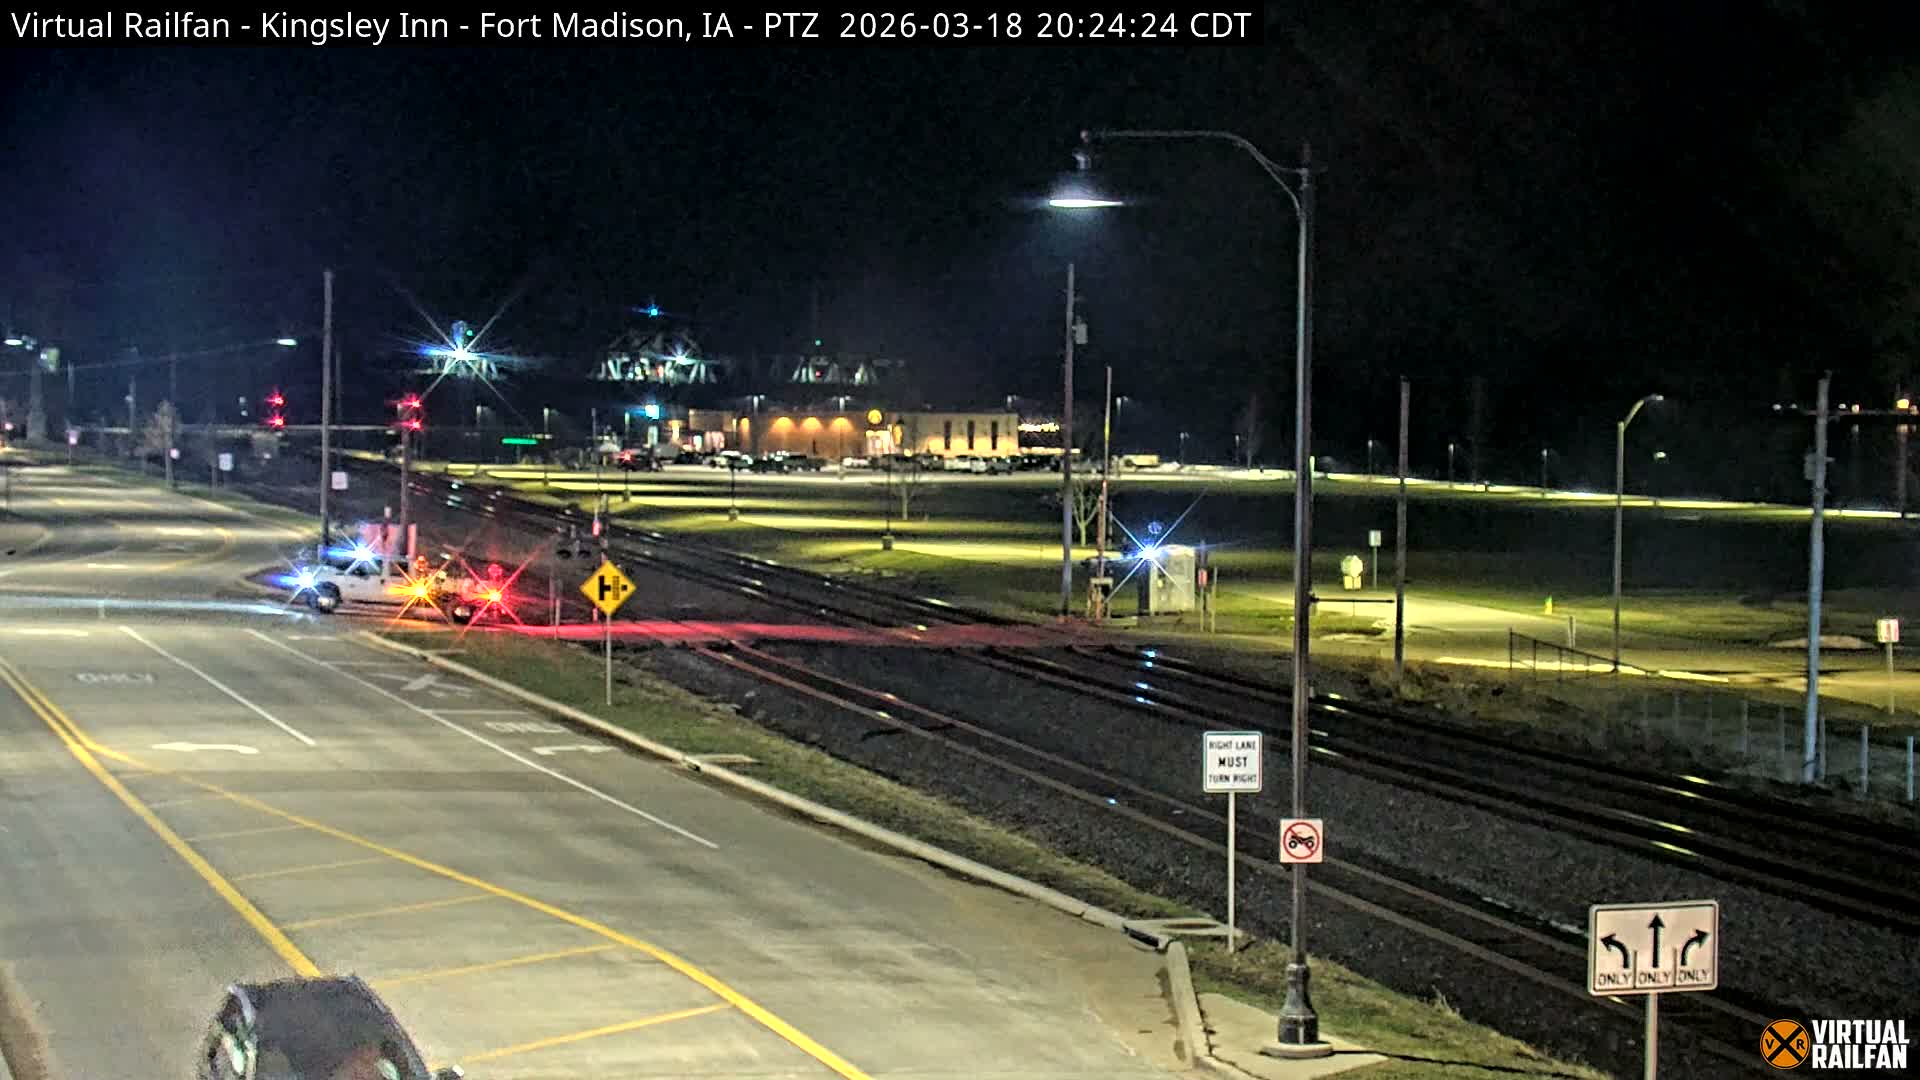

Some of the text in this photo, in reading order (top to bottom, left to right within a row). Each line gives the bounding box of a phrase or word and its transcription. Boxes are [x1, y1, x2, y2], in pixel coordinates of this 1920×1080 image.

[1209, 740, 1256, 750] RIGHT LANE
[1218, 756, 1248, 767] MUST
[1209, 774, 1257, 784] TURN RIGHT
[1598, 969, 1711, 985] ONLY ONLY ONLY
